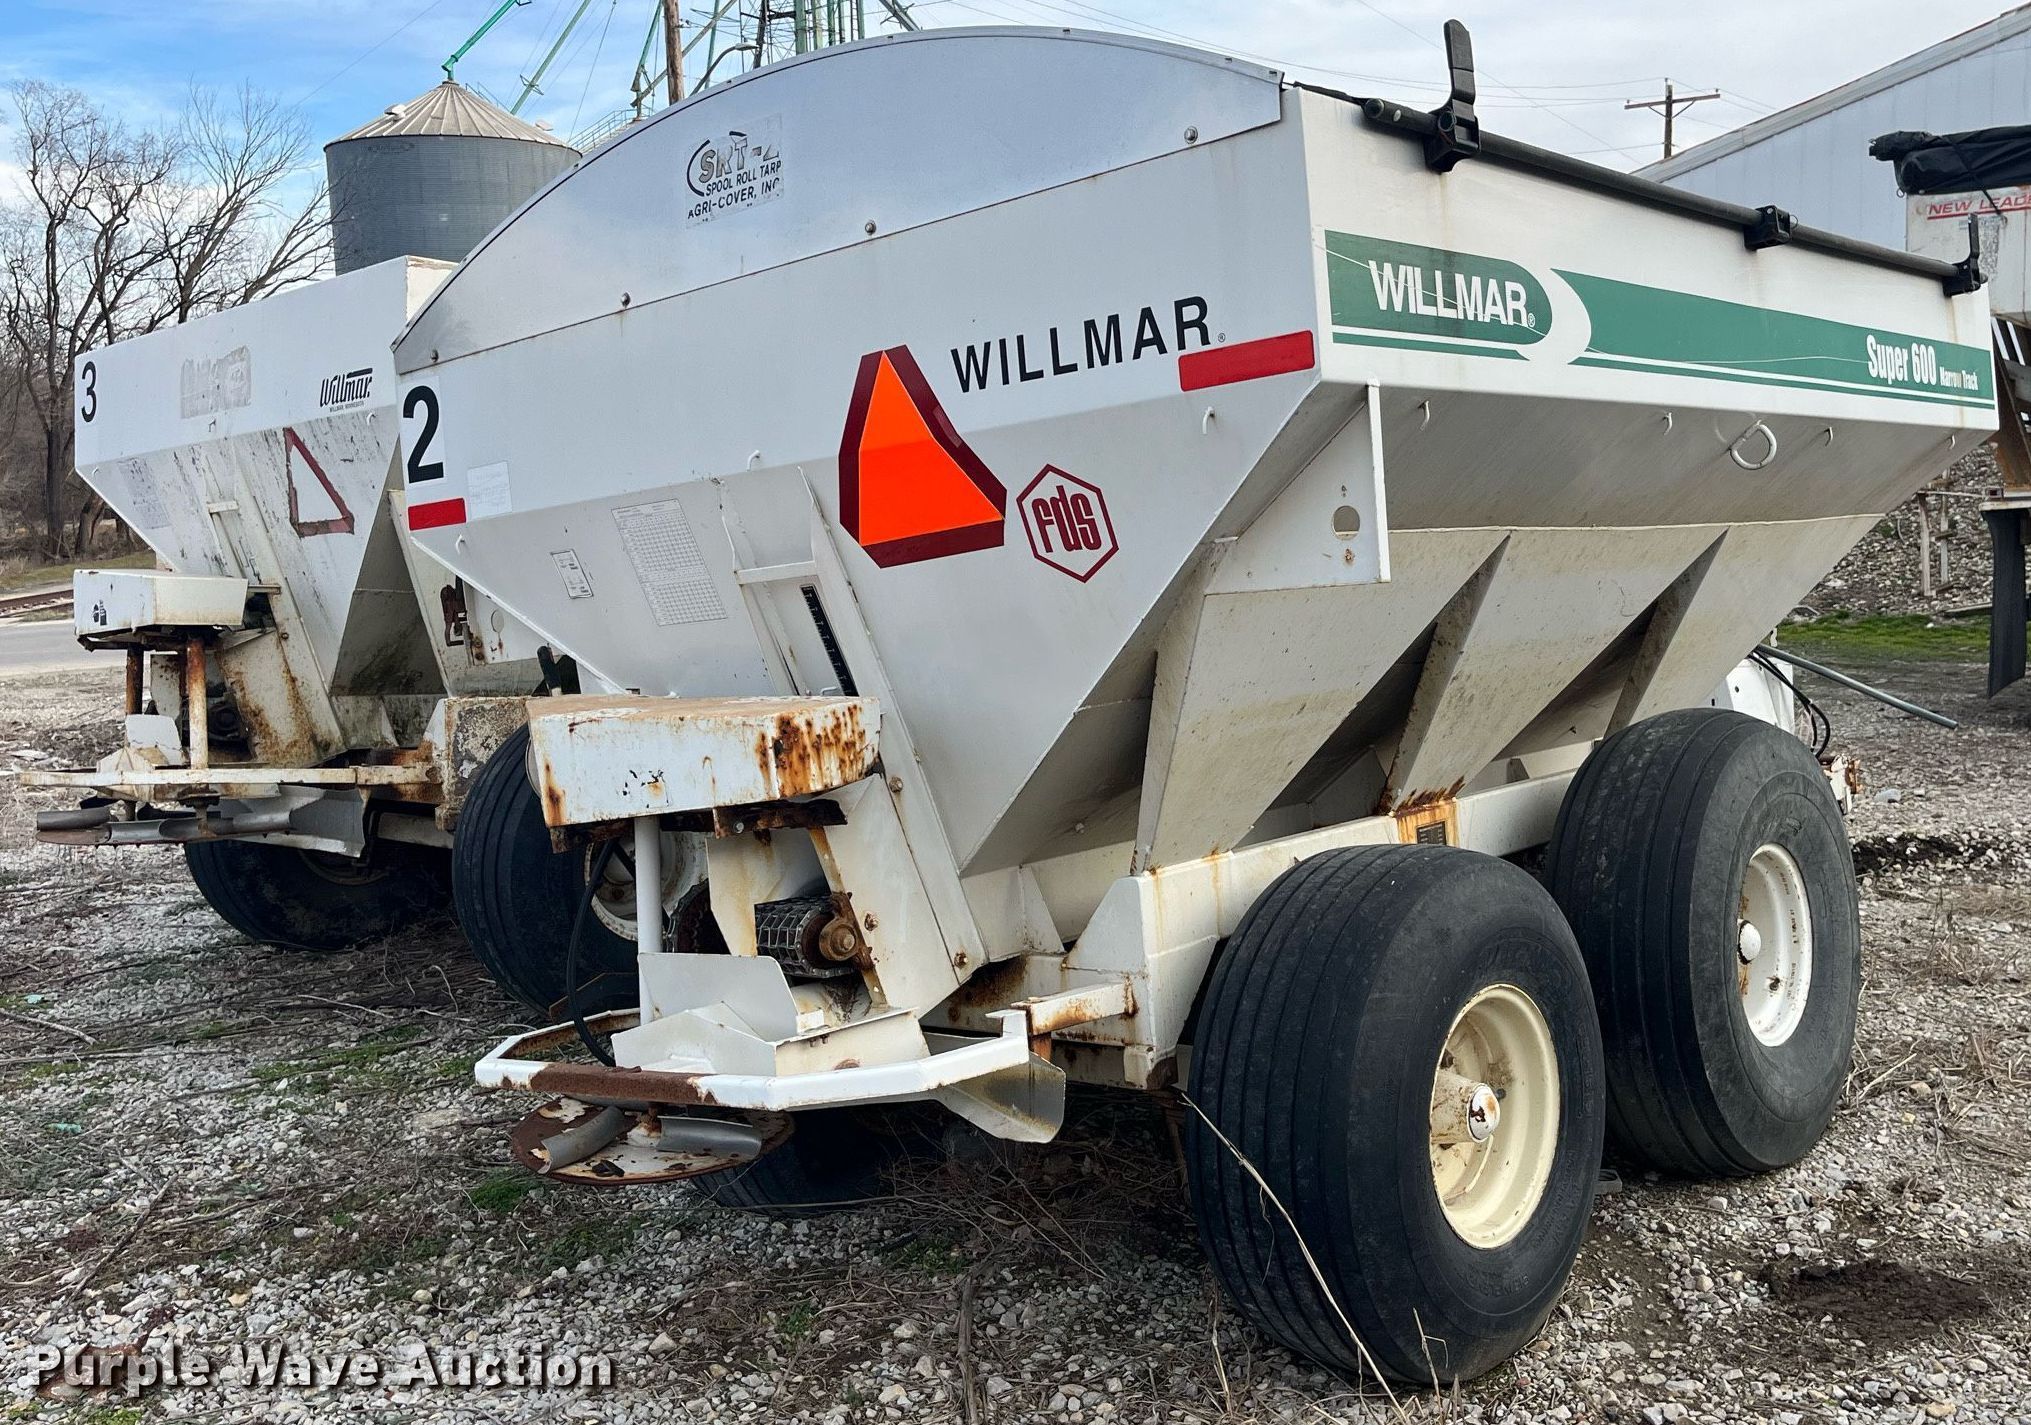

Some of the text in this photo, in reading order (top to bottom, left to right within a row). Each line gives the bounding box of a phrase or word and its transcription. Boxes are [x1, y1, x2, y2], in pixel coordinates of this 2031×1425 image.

[706, 160, 782, 197] SPOOL ROLL TARP
[687, 186, 757, 219] AGRI-COVER,
[1927, 200, 1973, 216] NEW
[1866, 334, 1909, 385] Super
[1911, 342, 1937, 386] 600
[81, 361, 97, 423] 3
[402, 385, 444, 484] 2
